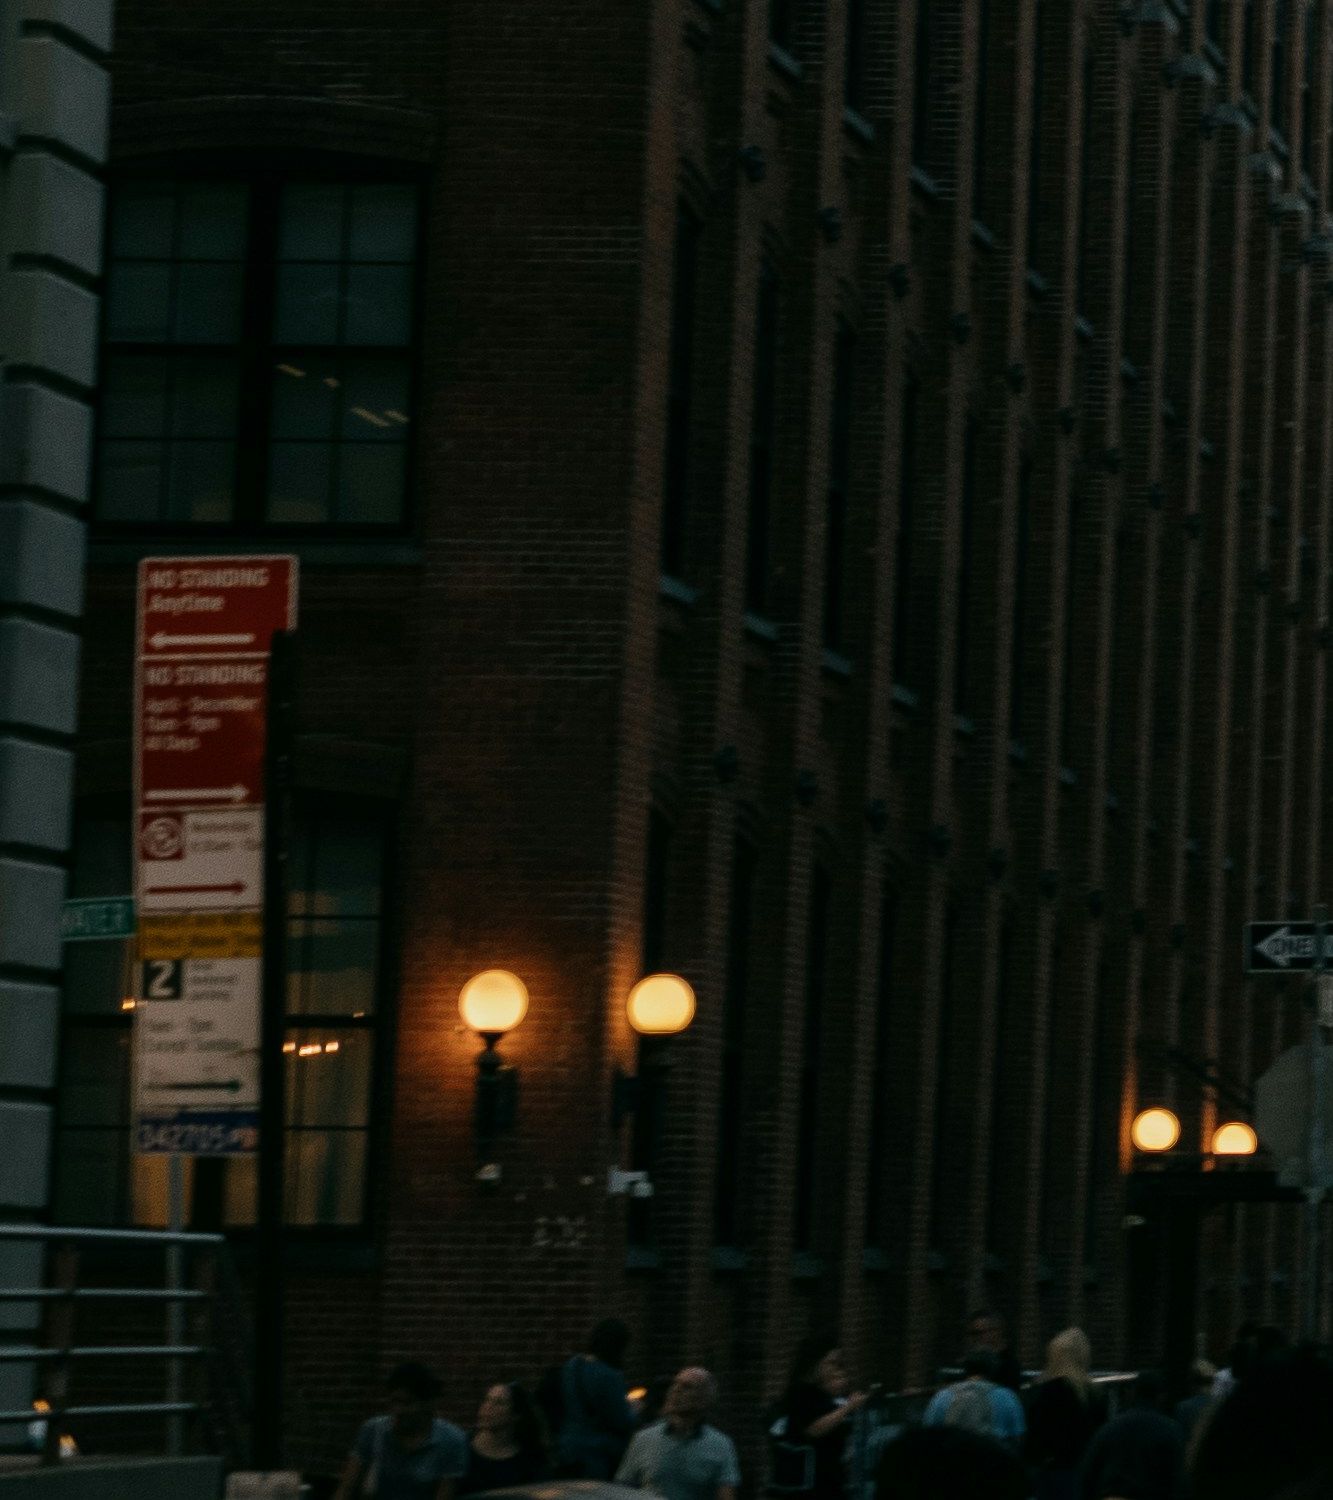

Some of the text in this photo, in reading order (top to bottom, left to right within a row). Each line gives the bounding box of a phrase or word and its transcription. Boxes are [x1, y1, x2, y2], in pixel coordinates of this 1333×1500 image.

[147, 567, 269, 588] NO STANDING
[148, 592, 226, 617] Anytime
[146, 664, 266, 686] NO STANDING
[1267, 938, 1313, 956] ONE
[148, 961, 174, 997] 2
